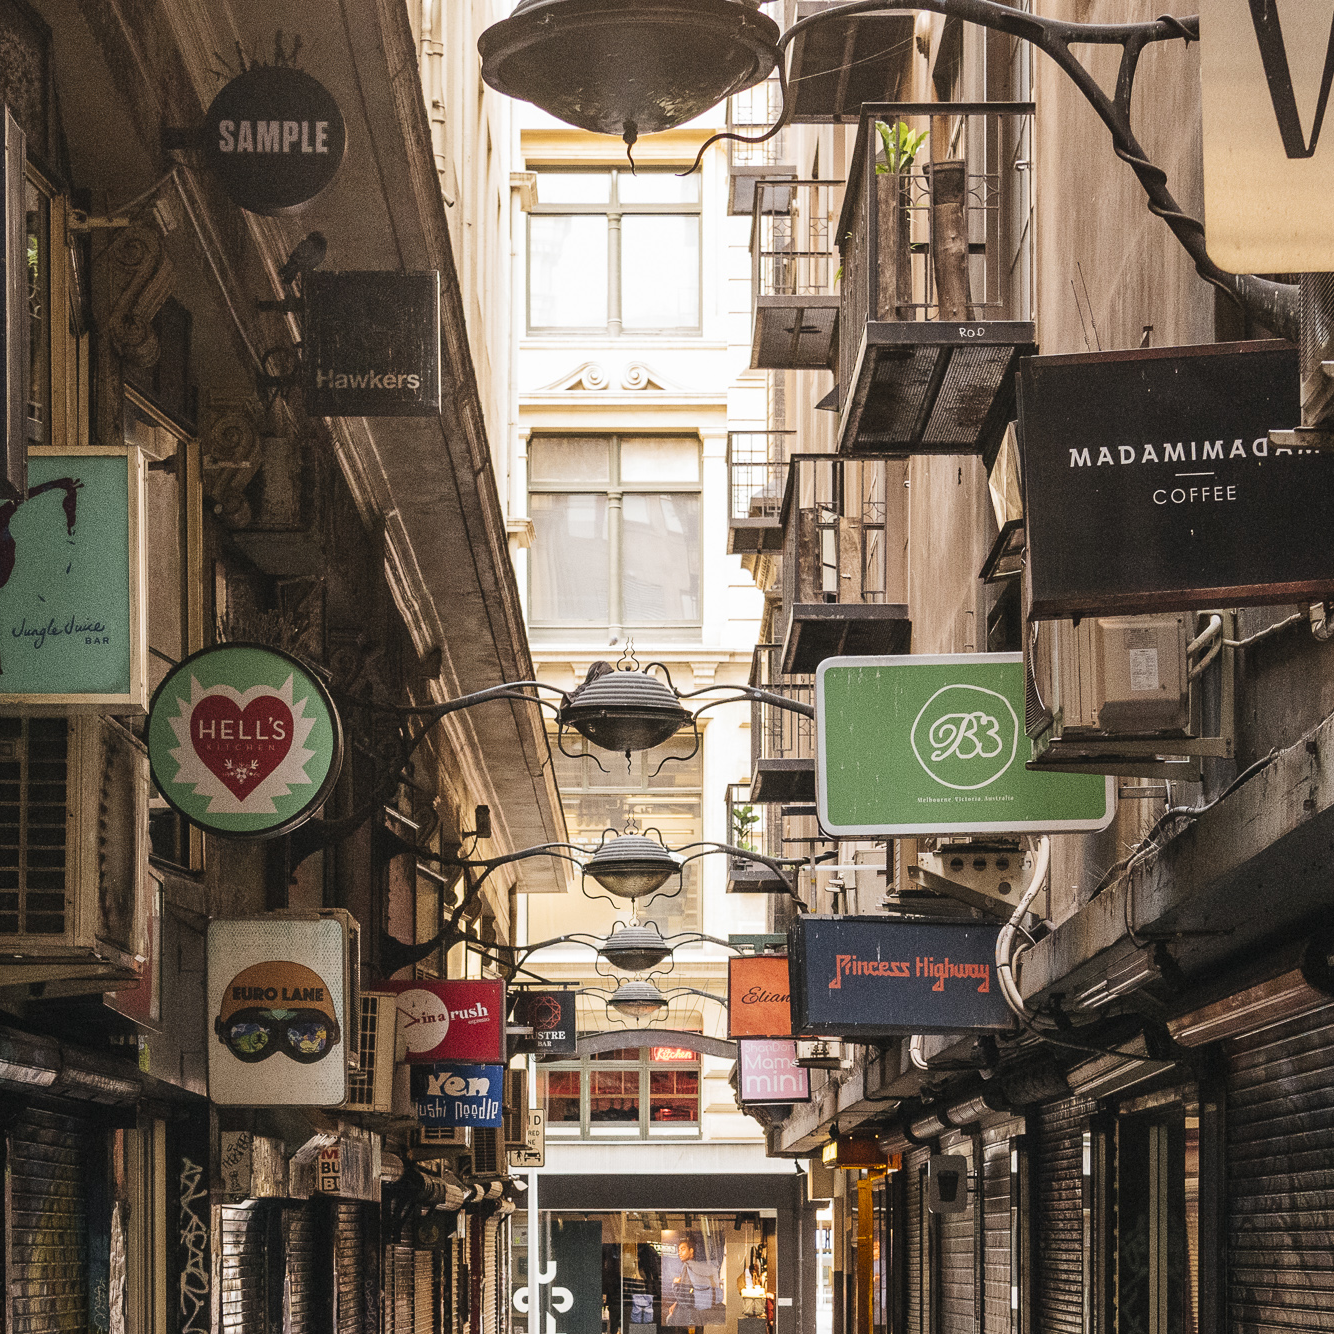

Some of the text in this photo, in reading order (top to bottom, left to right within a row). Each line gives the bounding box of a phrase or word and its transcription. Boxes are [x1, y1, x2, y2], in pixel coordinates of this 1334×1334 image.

[218, 119, 329, 153] SAMPLE
[316, 368, 421, 391] Hawkers
[1069, 438, 1320, 468] MADAMIMAD
[1152, 485, 1238, 505] COFFEE
[12, 614, 105, 649] Jungle Juice
[84, 637, 110, 645] BAR
[199, 716, 286, 740] HELL'S
[829, 955, 989, 993] Princess Highway
[232, 987, 324, 1002] EURO LANE
[741, 986, 790, 1004] Elian
[421, 1002, 489, 1024] in a rush
[525, 1031, 566, 1040] LUSTRE
[655, 1047, 692, 1060] Kitchen
[745, 1042, 794, 1055] ShanDon
[427, 1072, 490, 1097] Yen
[747, 1070, 803, 1093] mini
[417, 1101, 447, 1118] ushi
